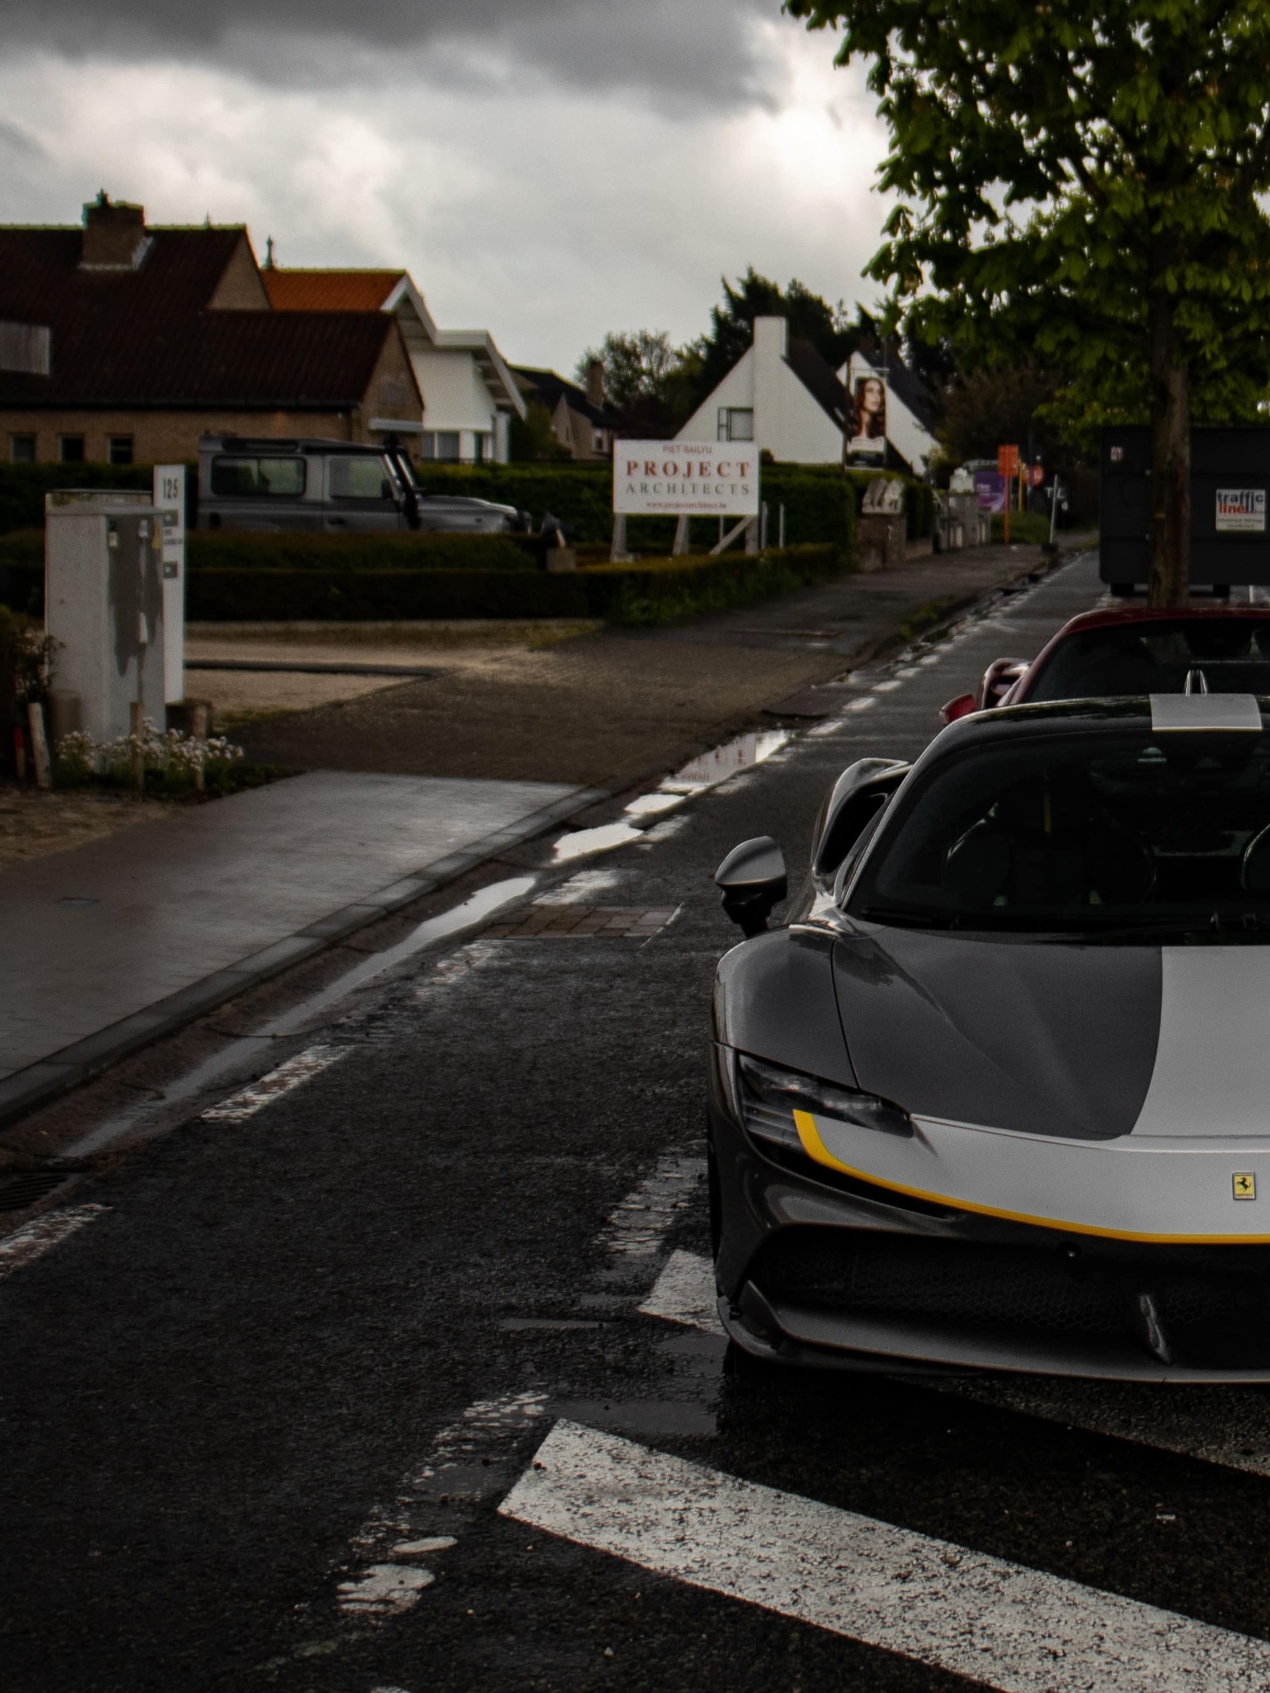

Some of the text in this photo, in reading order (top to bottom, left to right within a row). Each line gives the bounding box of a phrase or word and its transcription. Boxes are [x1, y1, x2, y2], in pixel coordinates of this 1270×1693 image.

[626, 460, 749, 478] PROJECT
[163, 477, 179, 499] 125
[626, 482, 749, 495] ARCHITECTS
[1218, 491, 1264, 510] traffic
